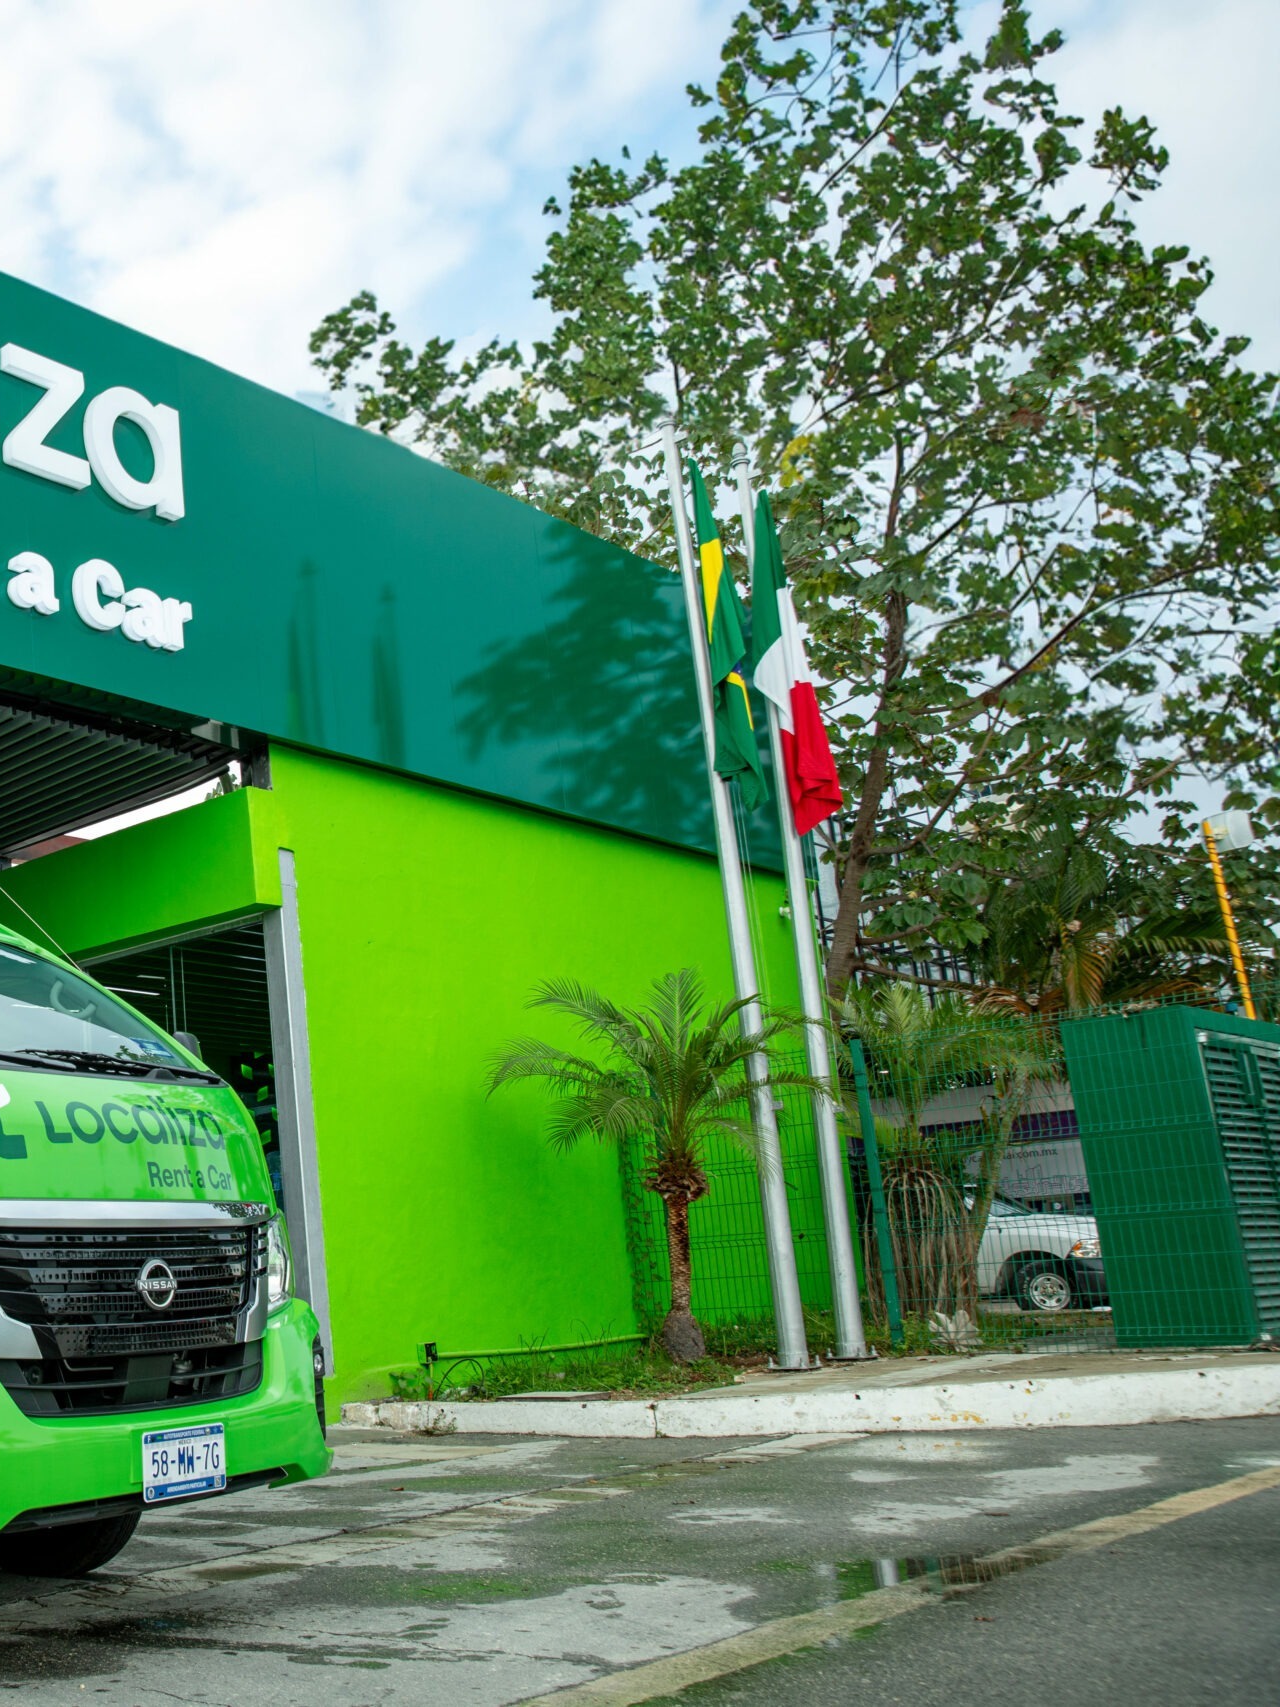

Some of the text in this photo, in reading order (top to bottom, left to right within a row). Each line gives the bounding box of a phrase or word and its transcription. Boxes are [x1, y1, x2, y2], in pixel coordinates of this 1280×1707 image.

[7, 551, 60, 615] a
[72, 558, 192, 652] Car
[34, 1095, 226, 1151] Localiza
[147, 1161, 232, 1191] Rent a Car
[139, 1280, 177, 1290] NISSAN
[151, 1442, 220, 1478] 58-MW-7G
